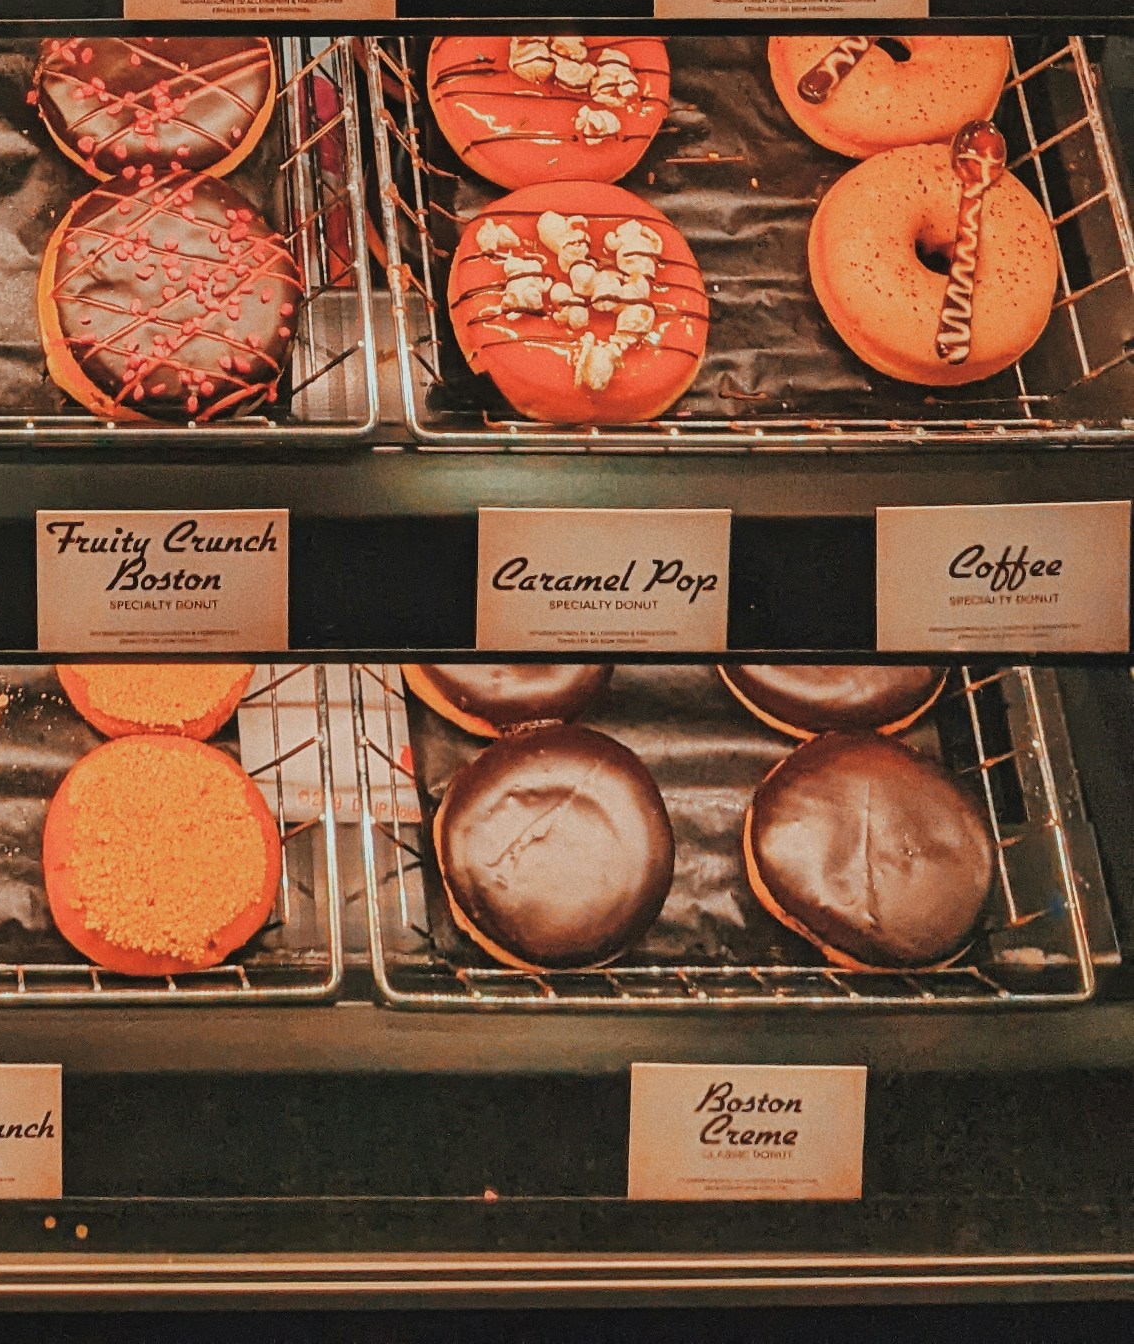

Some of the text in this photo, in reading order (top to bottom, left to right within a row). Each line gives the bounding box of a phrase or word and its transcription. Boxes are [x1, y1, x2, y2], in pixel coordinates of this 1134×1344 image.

[46, 519, 277, 558] Fruity Crunch
[105, 557, 222, 591] Boston
[492, 557, 718, 604] Caramel Pop
[948, 544, 1063, 592] Coffee
[109, 599, 219, 611] SPECIALTY DONUT
[549, 600, 658, 611] SPECIALTY DONUT
[949, 593, 1060, 607] SPECIALTY DONUT
[693, 1081, 803, 1113] Boston
[699, 1113, 799, 1146] Creme
